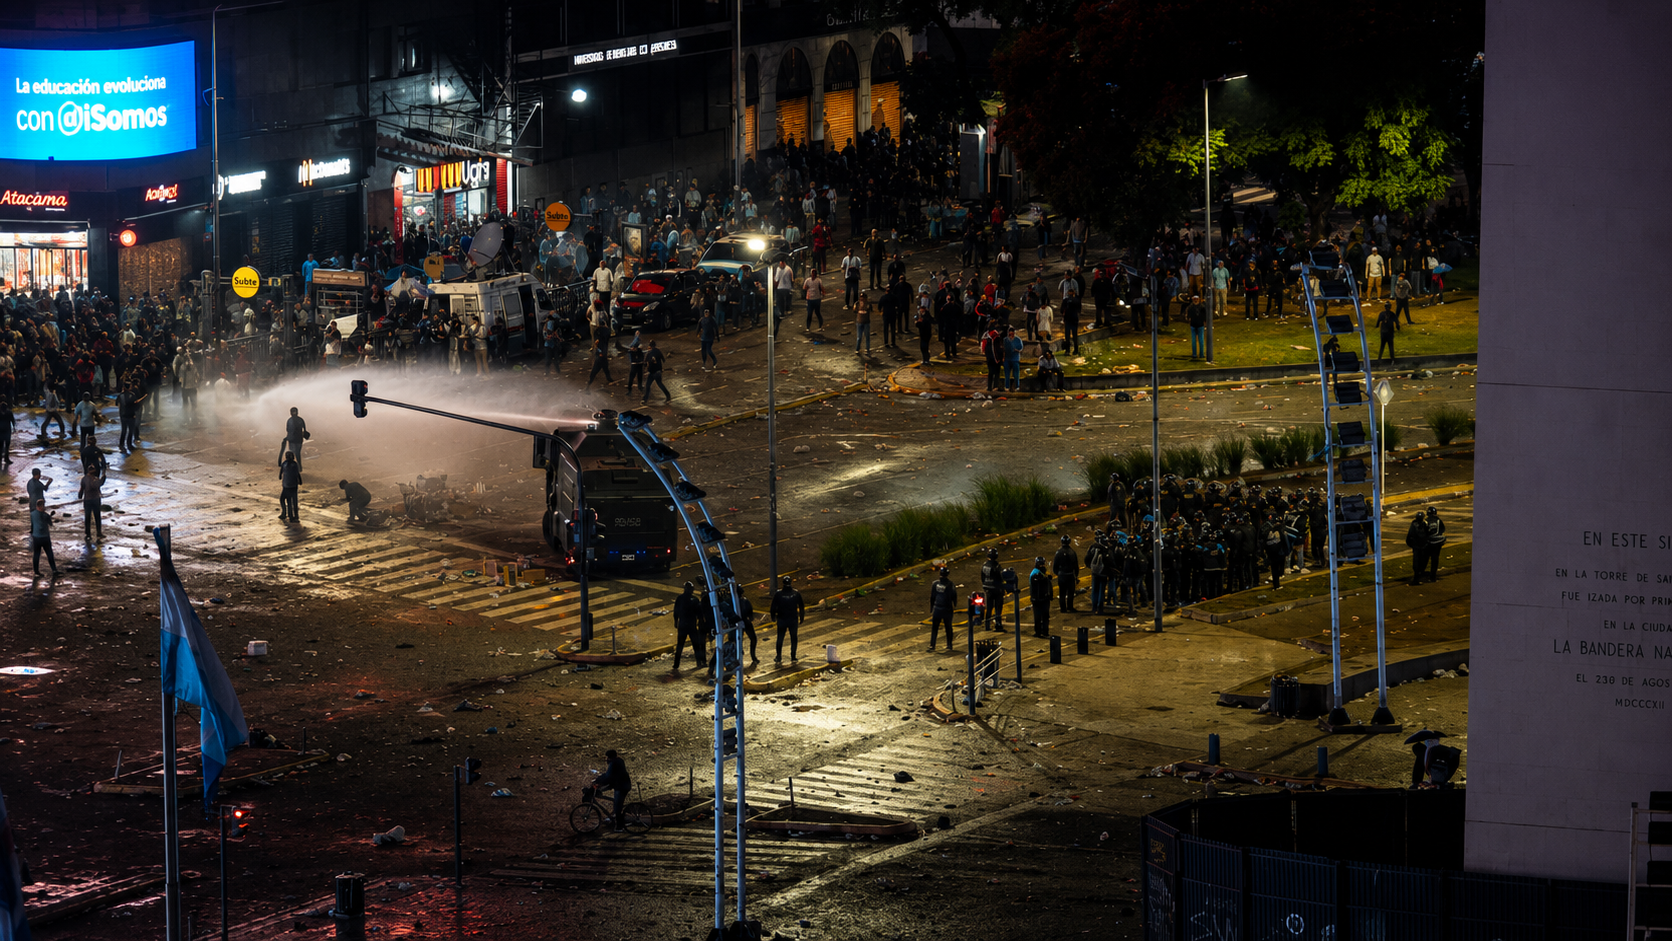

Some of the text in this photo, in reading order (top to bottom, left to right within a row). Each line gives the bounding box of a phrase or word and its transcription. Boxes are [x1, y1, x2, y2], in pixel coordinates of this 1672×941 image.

[16, 75, 166, 94] La educación evoluciona
[16, 109, 54, 131] con
[0, 190, 68, 207] Atacama
[234, 276, 257, 286] Subte
[1583, 531, 1671, 549] EN ESTE SI
[1555, 568, 1568, 577] EN
[1575, 569, 1588, 579] LA
[1594, 571, 1628, 582] TORRE
[1636, 573, 1649, 583] DE
[1561, 591, 1580, 601] FUE
[1587, 593, 1618, 603] IZADA
[1624, 595, 1646, 605] POR
[1603, 620, 1672, 633] EN LA CIUDA
[1553, 639, 1672, 660] LA BANDERA NA
[1576, 673, 1588, 683] EL
[1621, 676, 1635, 686] DE
[1641, 678, 1670, 688] AGOS
[1615, 698, 1665, 709] MDCCCXII
